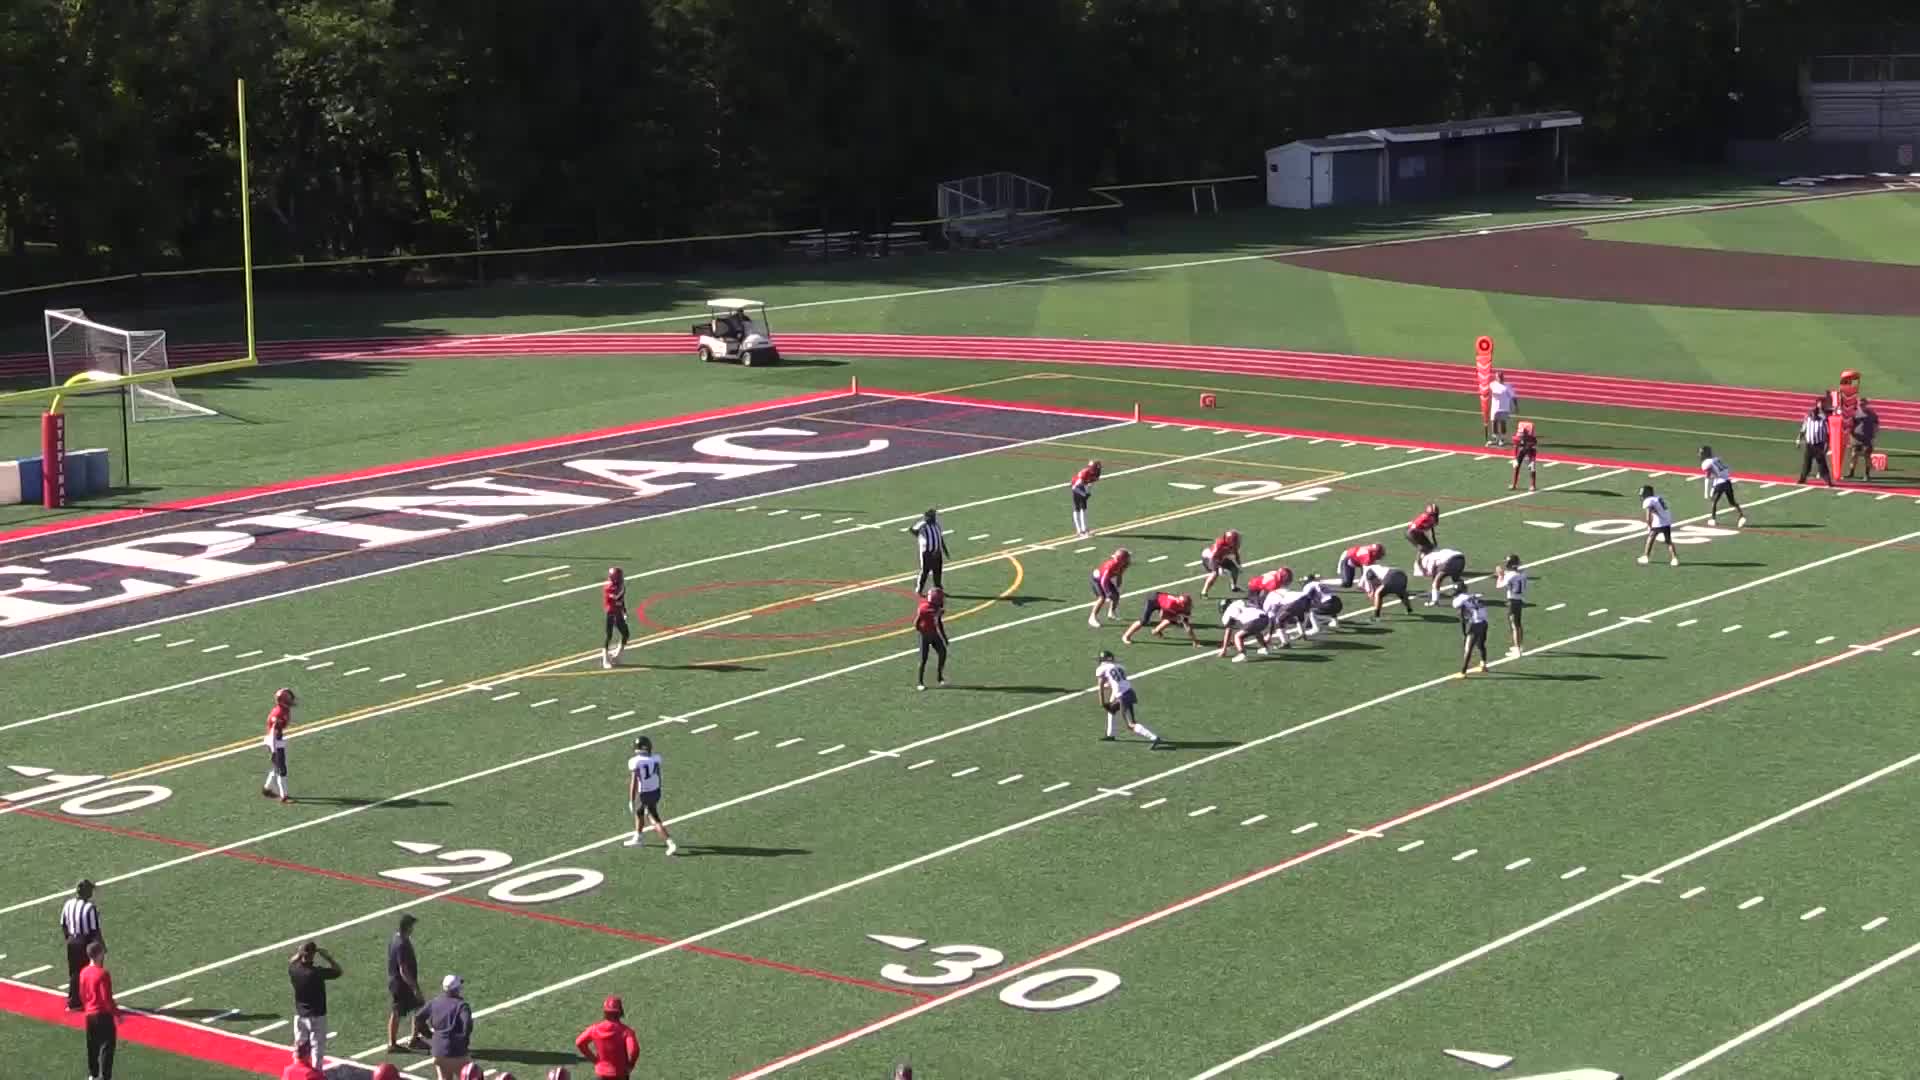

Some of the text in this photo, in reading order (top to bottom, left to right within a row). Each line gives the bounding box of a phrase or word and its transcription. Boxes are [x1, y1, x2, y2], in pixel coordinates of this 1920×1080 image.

[640, 762, 661, 780] 14
[0, 774, 173, 816] 10
[377, 849, 604, 902] 20
[880, 944, 1121, 1010] 30
